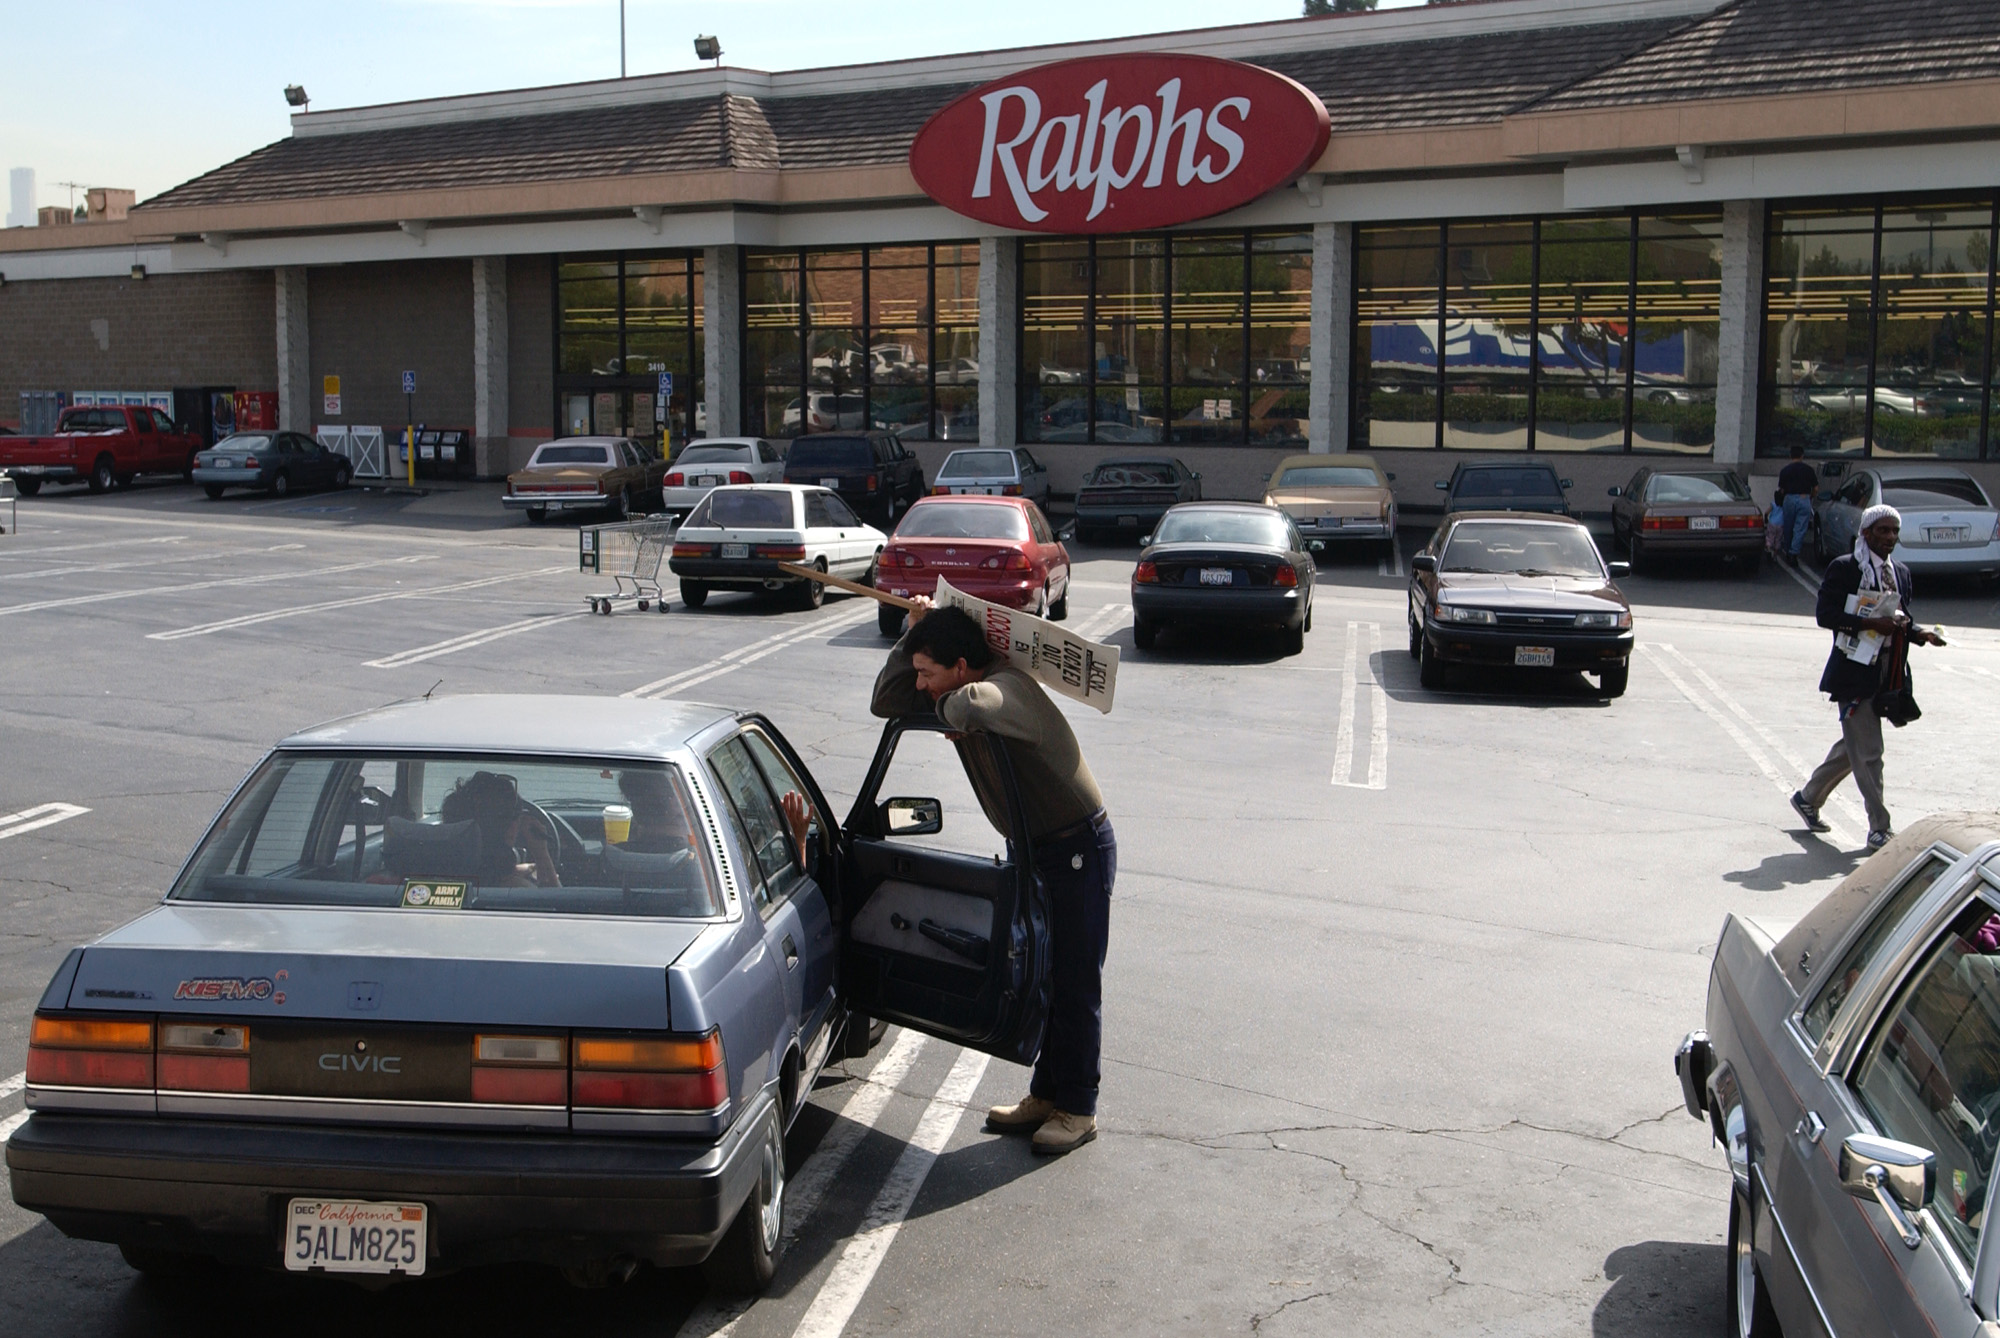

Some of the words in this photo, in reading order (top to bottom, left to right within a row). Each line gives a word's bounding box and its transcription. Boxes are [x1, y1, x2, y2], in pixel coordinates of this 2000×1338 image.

[971, 77, 1251, 223] Ralphs
[648, 362, 666, 372] 3410
[986, 607, 1011, 651] LOCKED
[1043, 643, 1062, 669] OUT
[1062, 640, 1083, 688] LOCKED
[1090, 660, 1107, 694] UFCW
[429, 896, 462, 906] FAMILY
[435, 886, 460, 895] ARMY
[318, 1053, 402, 1074] CIVIC
[295, 1205, 315, 1215] DEC
[319, 1203, 402, 1226] California
[295, 1225, 416, 1264] 5ALM825
